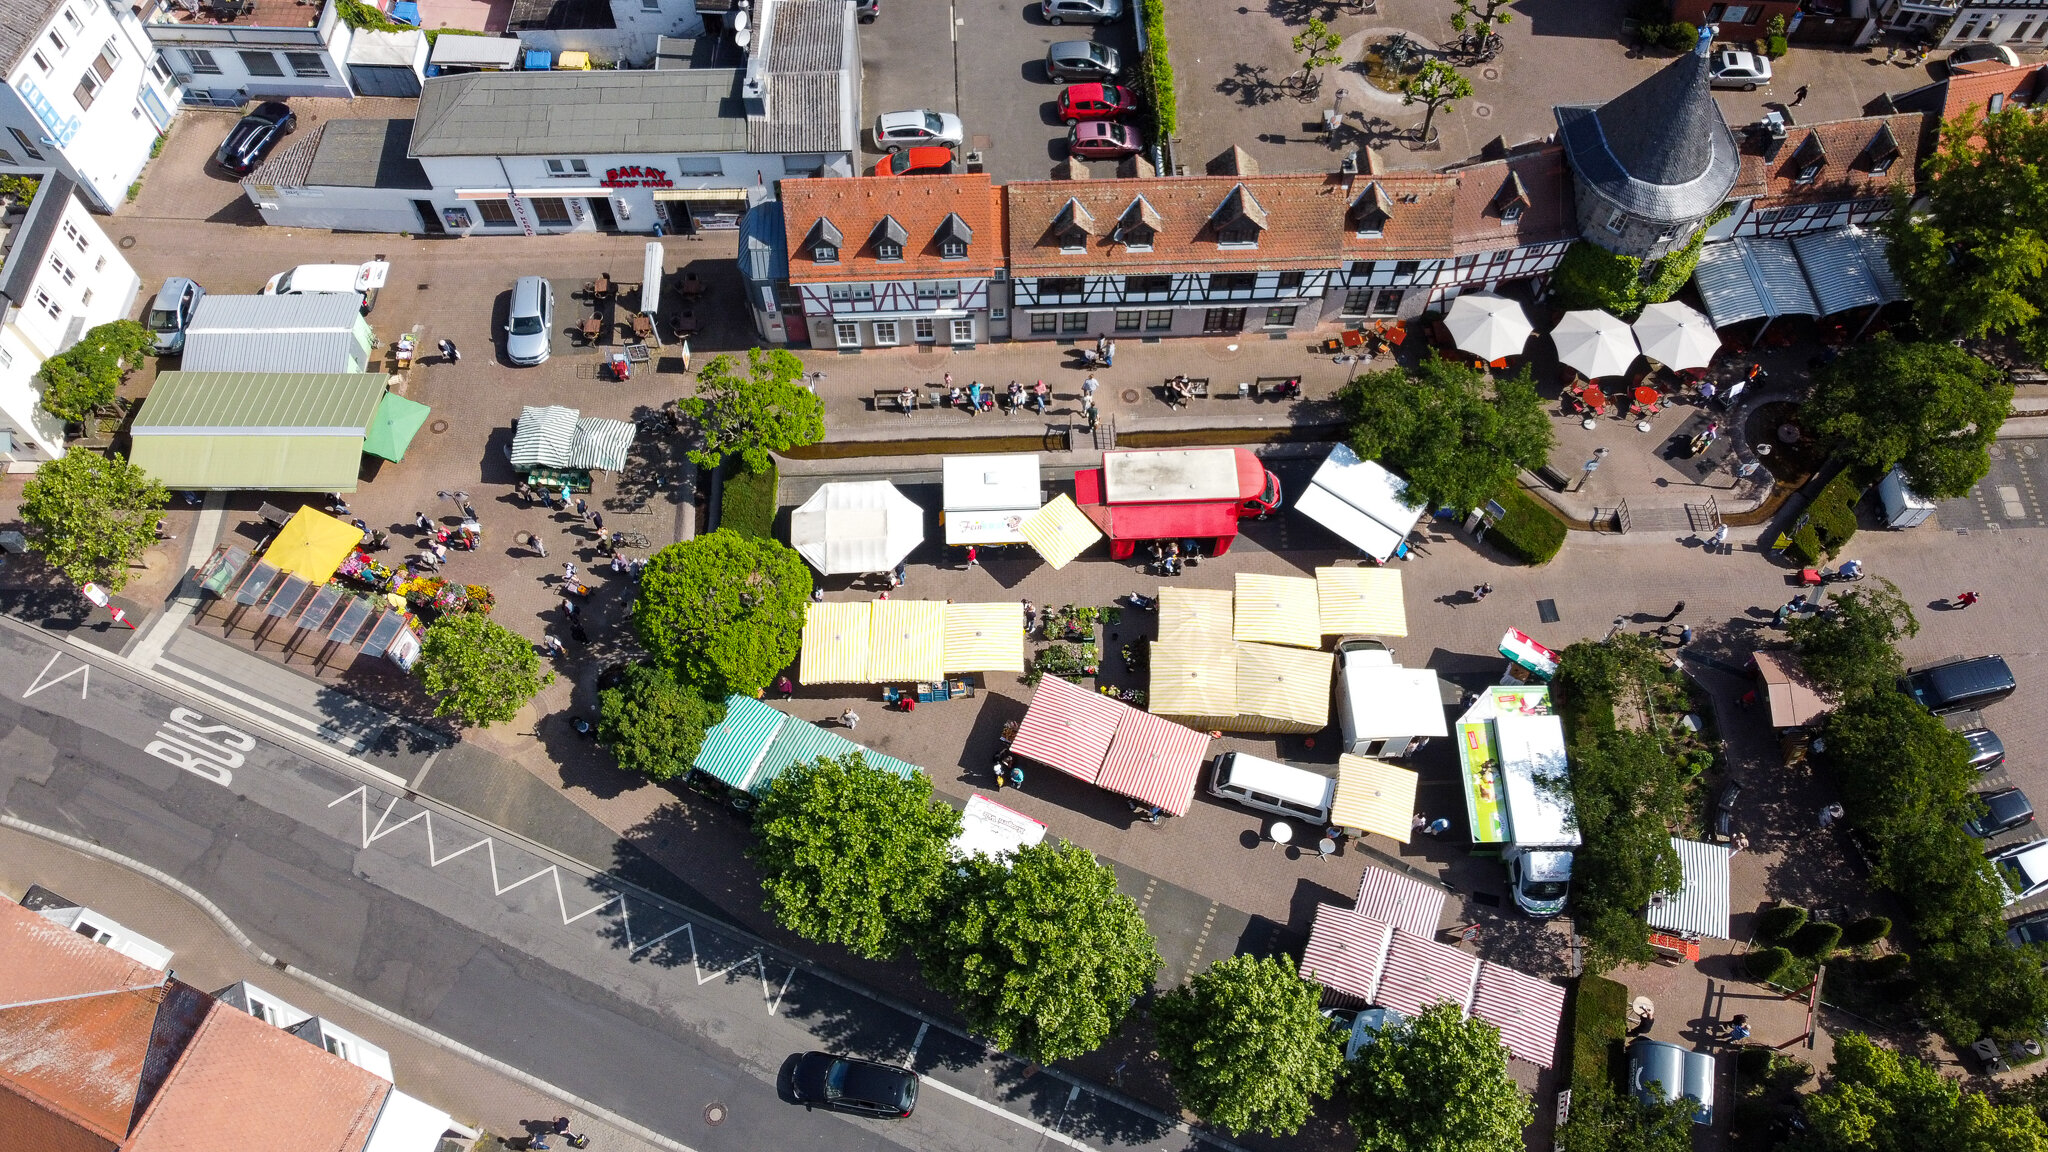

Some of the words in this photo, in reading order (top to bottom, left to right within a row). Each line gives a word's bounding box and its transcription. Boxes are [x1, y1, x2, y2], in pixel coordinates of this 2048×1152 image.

[21, 77, 66, 136] OPTIK
[600, 179, 639, 188] KEBAP
[606, 166, 666, 181] BAKAY
[144, 707, 256, 787] BUS
